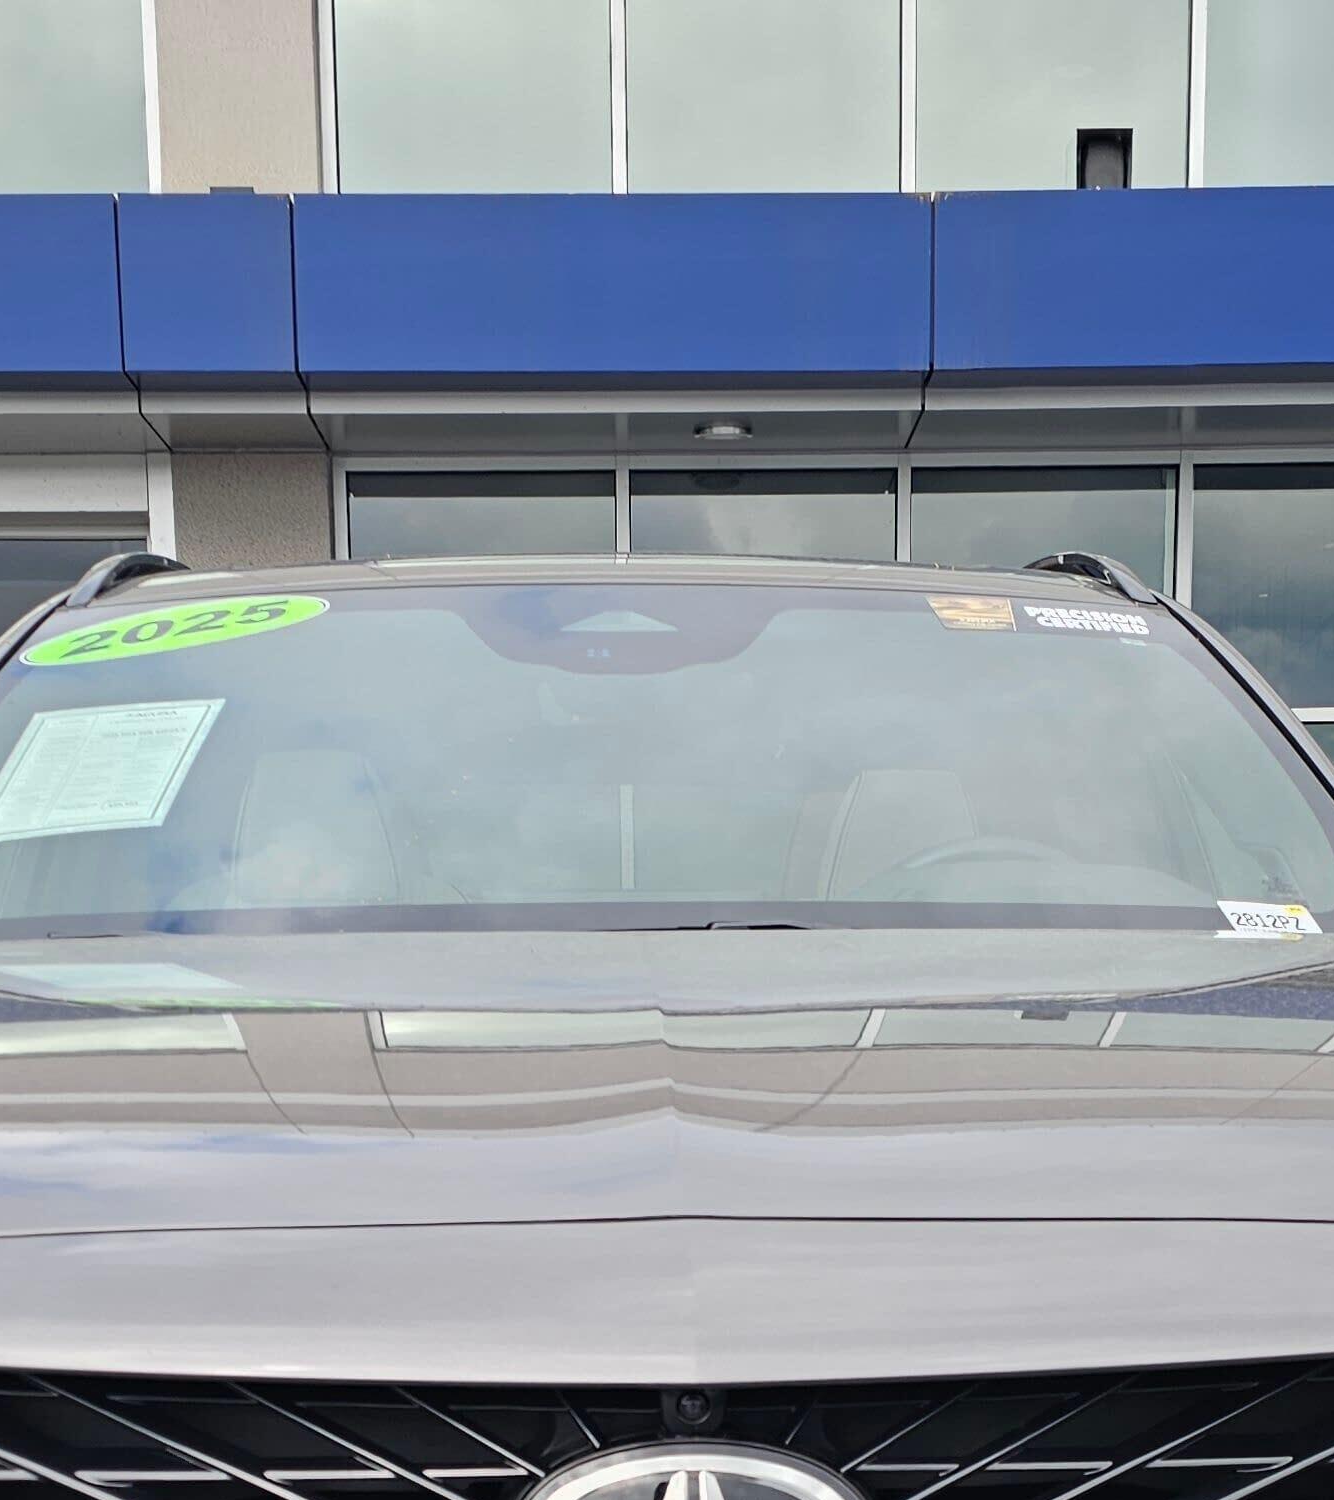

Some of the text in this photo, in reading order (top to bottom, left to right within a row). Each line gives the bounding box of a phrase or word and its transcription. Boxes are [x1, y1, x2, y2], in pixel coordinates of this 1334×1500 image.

[1024, 606, 1148, 626] PRECISION
[1036, 616, 1150, 635] CERTIFIED
[60, 600, 289, 659] 2025
